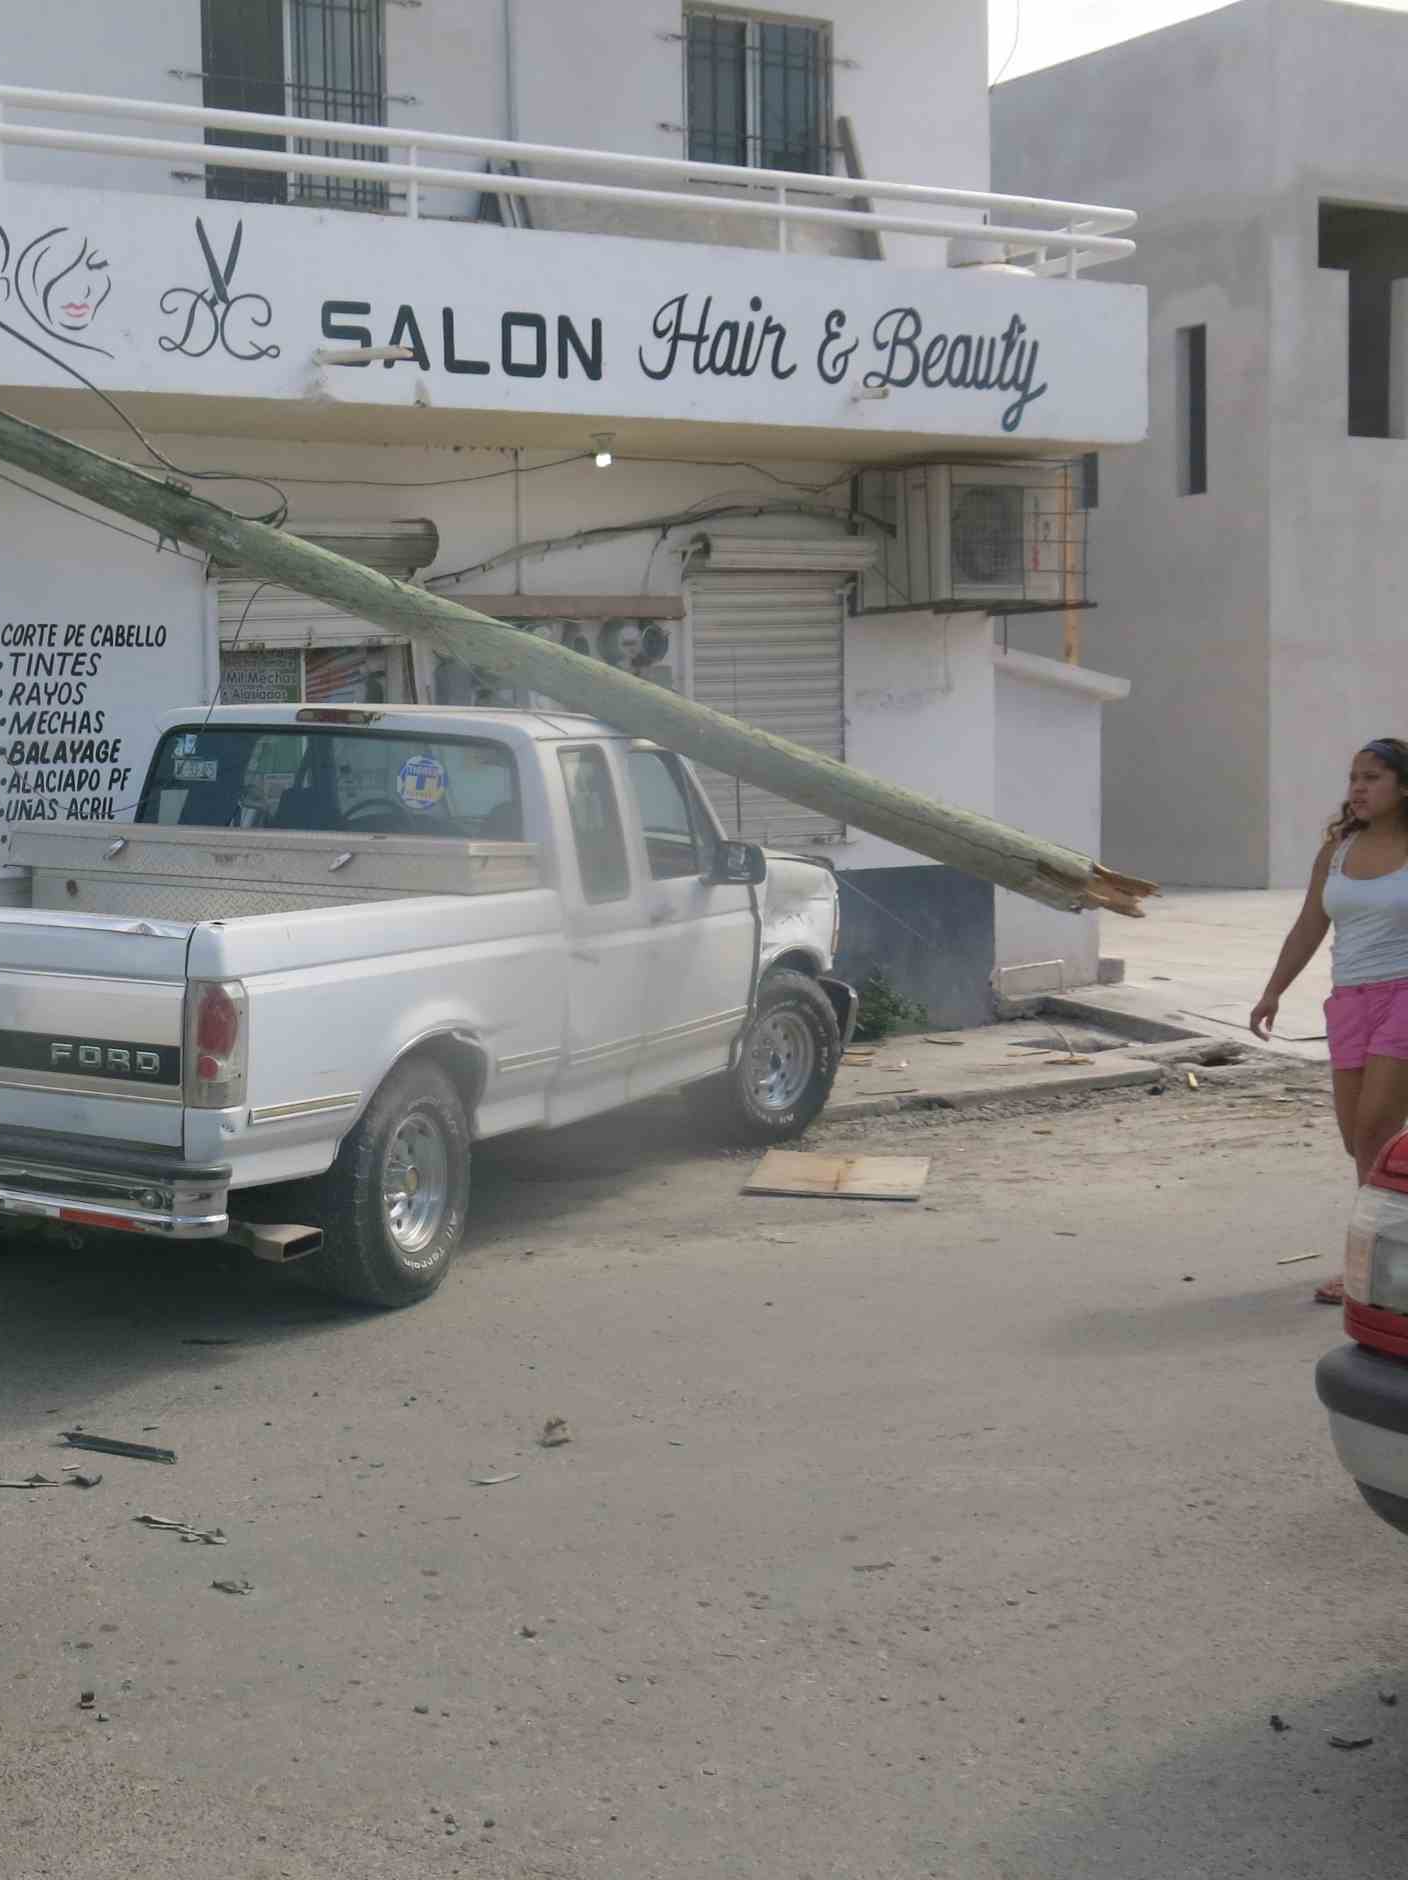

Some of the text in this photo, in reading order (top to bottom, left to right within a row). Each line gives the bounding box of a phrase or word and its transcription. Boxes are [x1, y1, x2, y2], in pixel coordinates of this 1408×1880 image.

[321, 293, 1048, 433] SALON Hair & Beauty
[1, 623, 167, 648] CORTE DE CABELLO
[8, 652, 102, 677] TINTES
[8, 682, 88, 705] RAYOS
[8, 711, 105, 736] MECHAS
[6, 739, 122, 766] BALAYAGE
[7, 769, 101, 794] ALACIADO
[5, 797, 115, 822] UÑAS ACRIL
[50, 1041, 160, 1074] FORD
